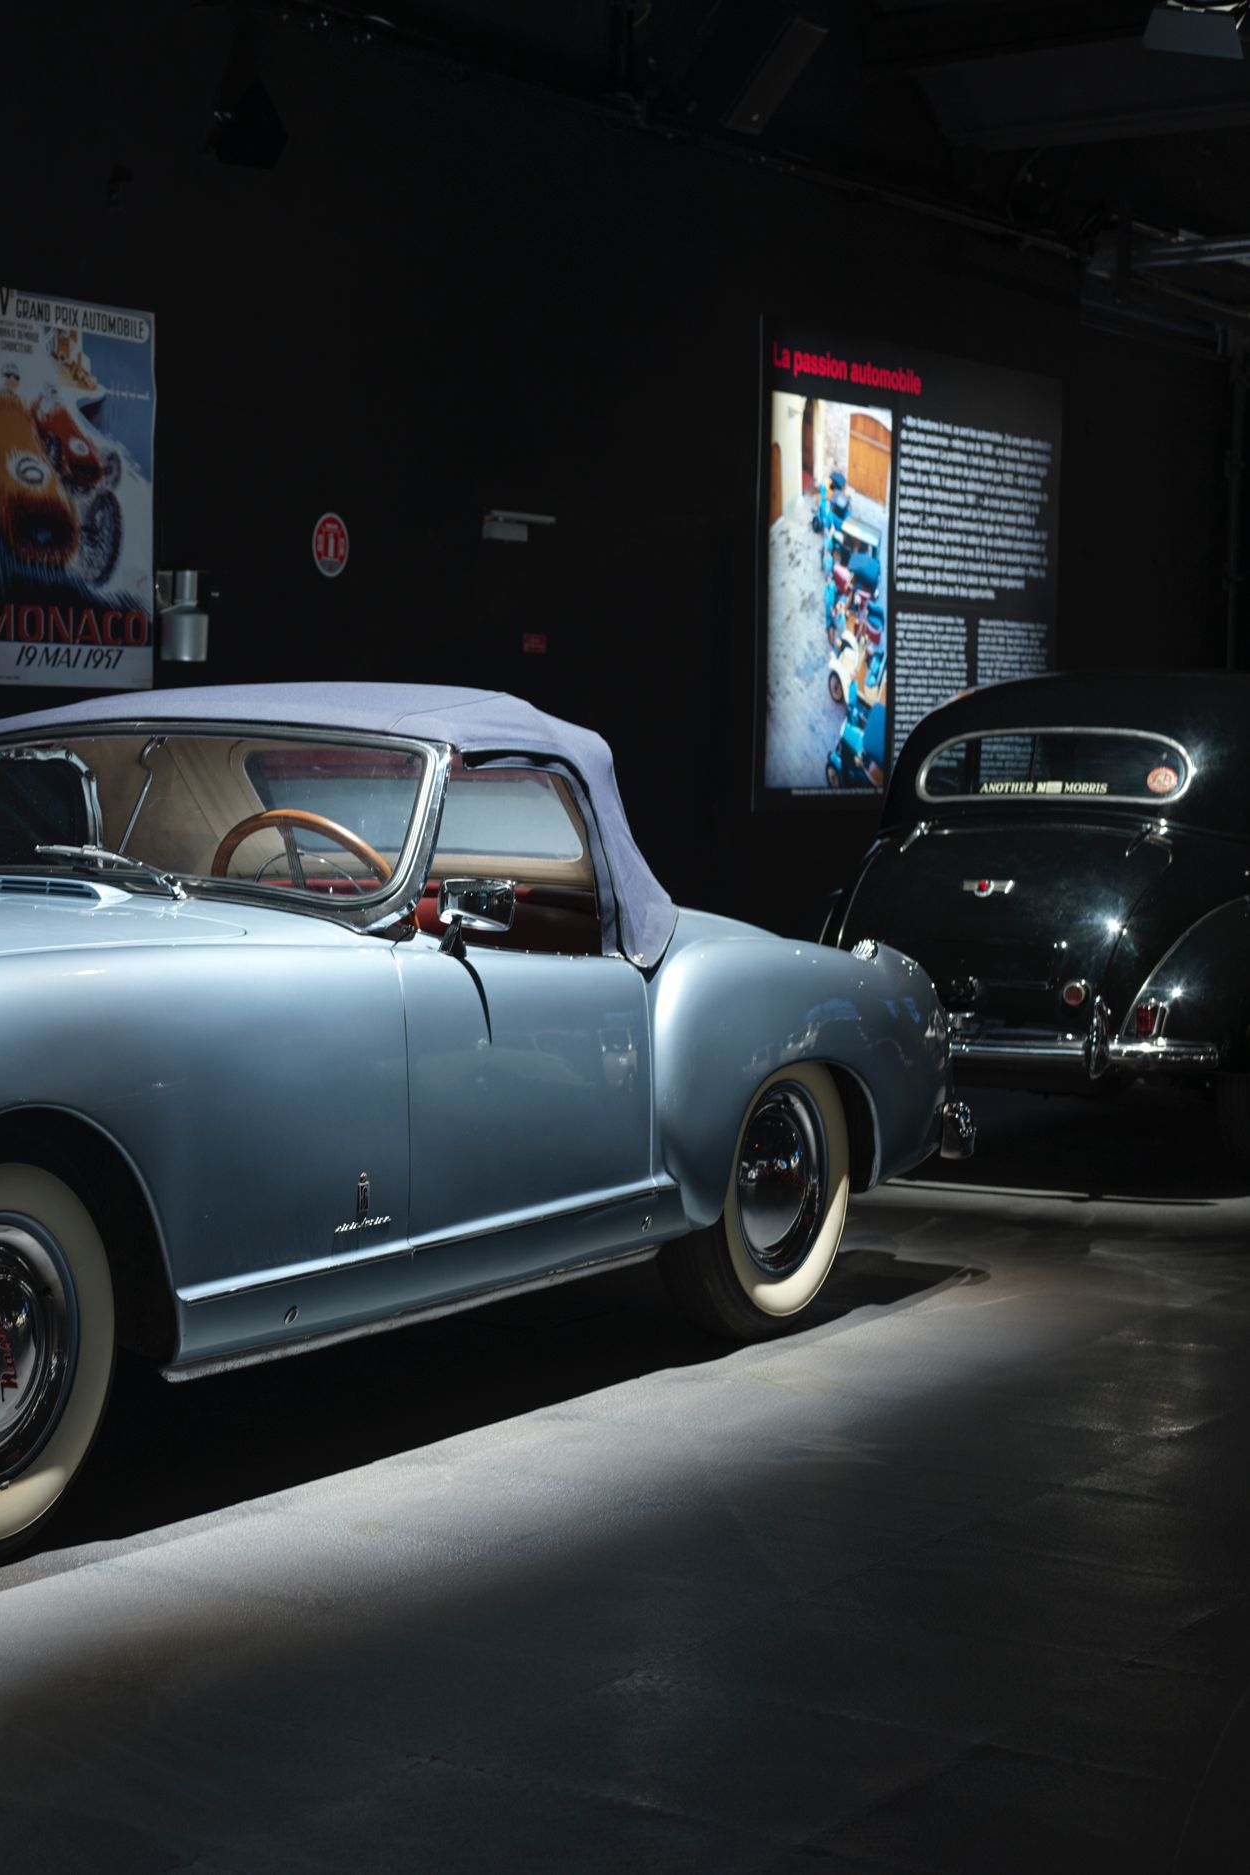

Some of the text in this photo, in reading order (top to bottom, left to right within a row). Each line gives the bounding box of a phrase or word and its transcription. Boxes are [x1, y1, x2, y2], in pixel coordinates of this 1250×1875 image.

[15, 298, 51, 324] GRAND
[55, 305, 80, 327] PRIX
[81, 309, 146, 340] AUTOMOBILE
[772, 341, 922, 396] La passion automobile
[15, 645, 125, 670] 19 MAI 1957
[980, 781, 1034, 794] ANOTHER
[1064, 782, 1108, 794] MORRIS
